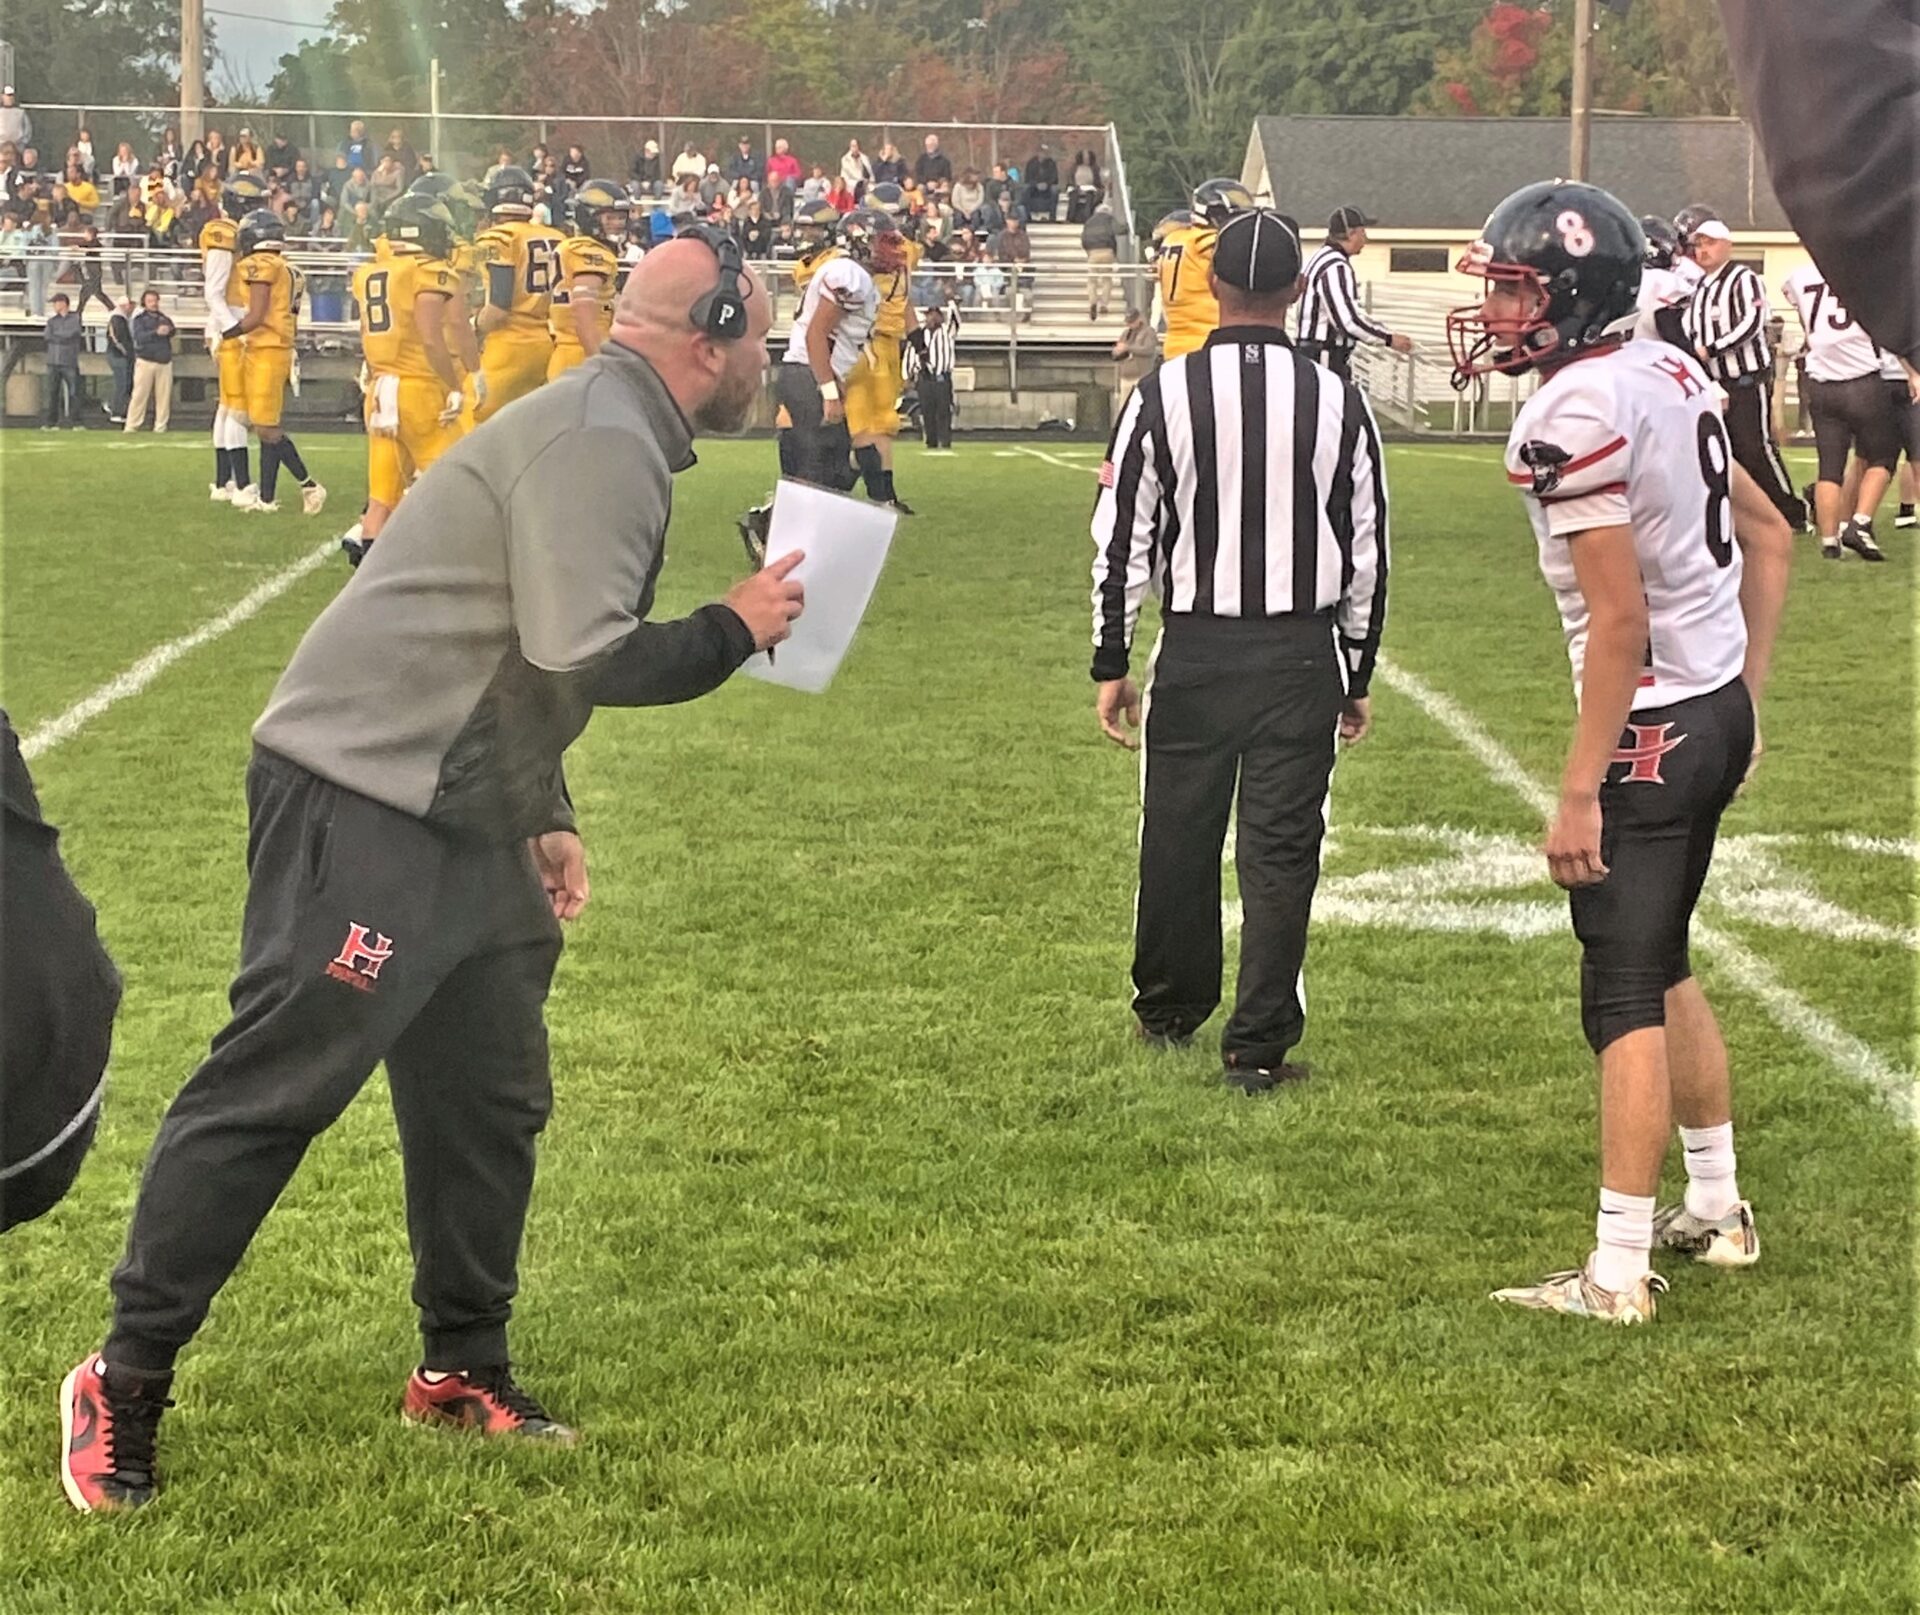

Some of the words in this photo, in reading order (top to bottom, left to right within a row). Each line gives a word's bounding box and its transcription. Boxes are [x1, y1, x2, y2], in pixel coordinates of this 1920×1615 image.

[1553, 208, 1596, 258] 8
[364, 270, 393, 334] 8
[718, 303, 735, 325] P
[1697, 410, 1733, 569] 8
[333, 920, 393, 979] H
